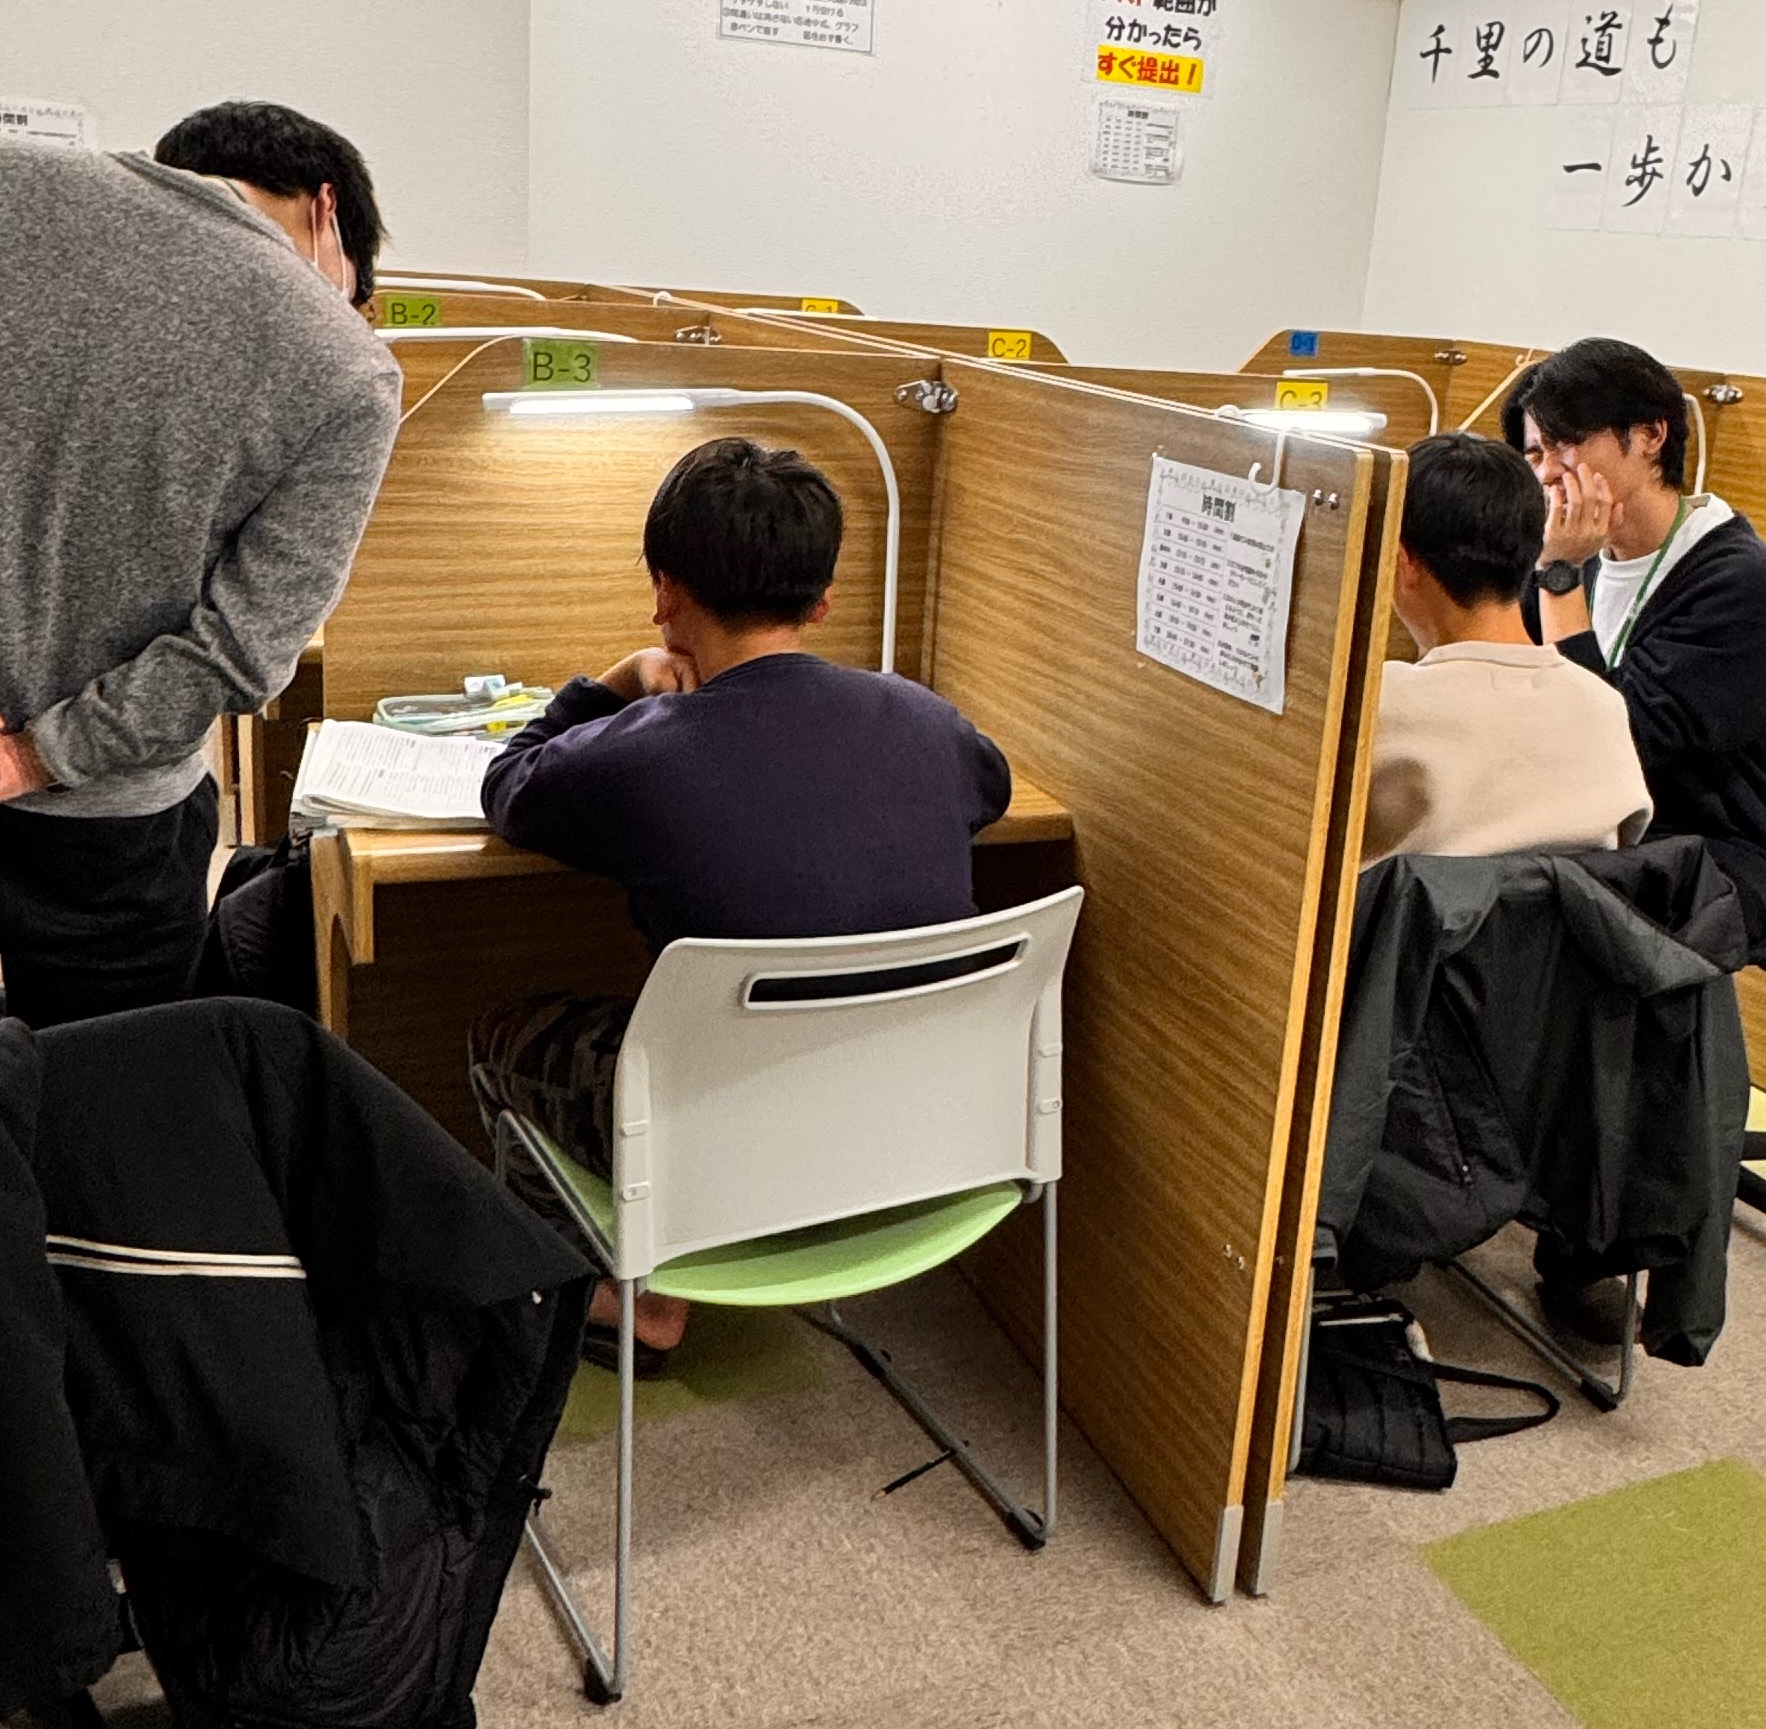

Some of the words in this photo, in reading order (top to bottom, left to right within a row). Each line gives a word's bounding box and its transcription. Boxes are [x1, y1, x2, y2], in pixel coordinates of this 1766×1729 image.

[1105, 16, 1202, 51] 分かったら
[1420, 3, 1677, 83] 千里の道も
[0, 112, 28, 126] 間割
[1563, 135, 1732, 207] 一歩か
[391, 302, 436, 326] B-2
[992, 338, 1028, 359] C-2
[532, 351, 591, 383] B-3
[1279, 390, 1322, 409] C-3
